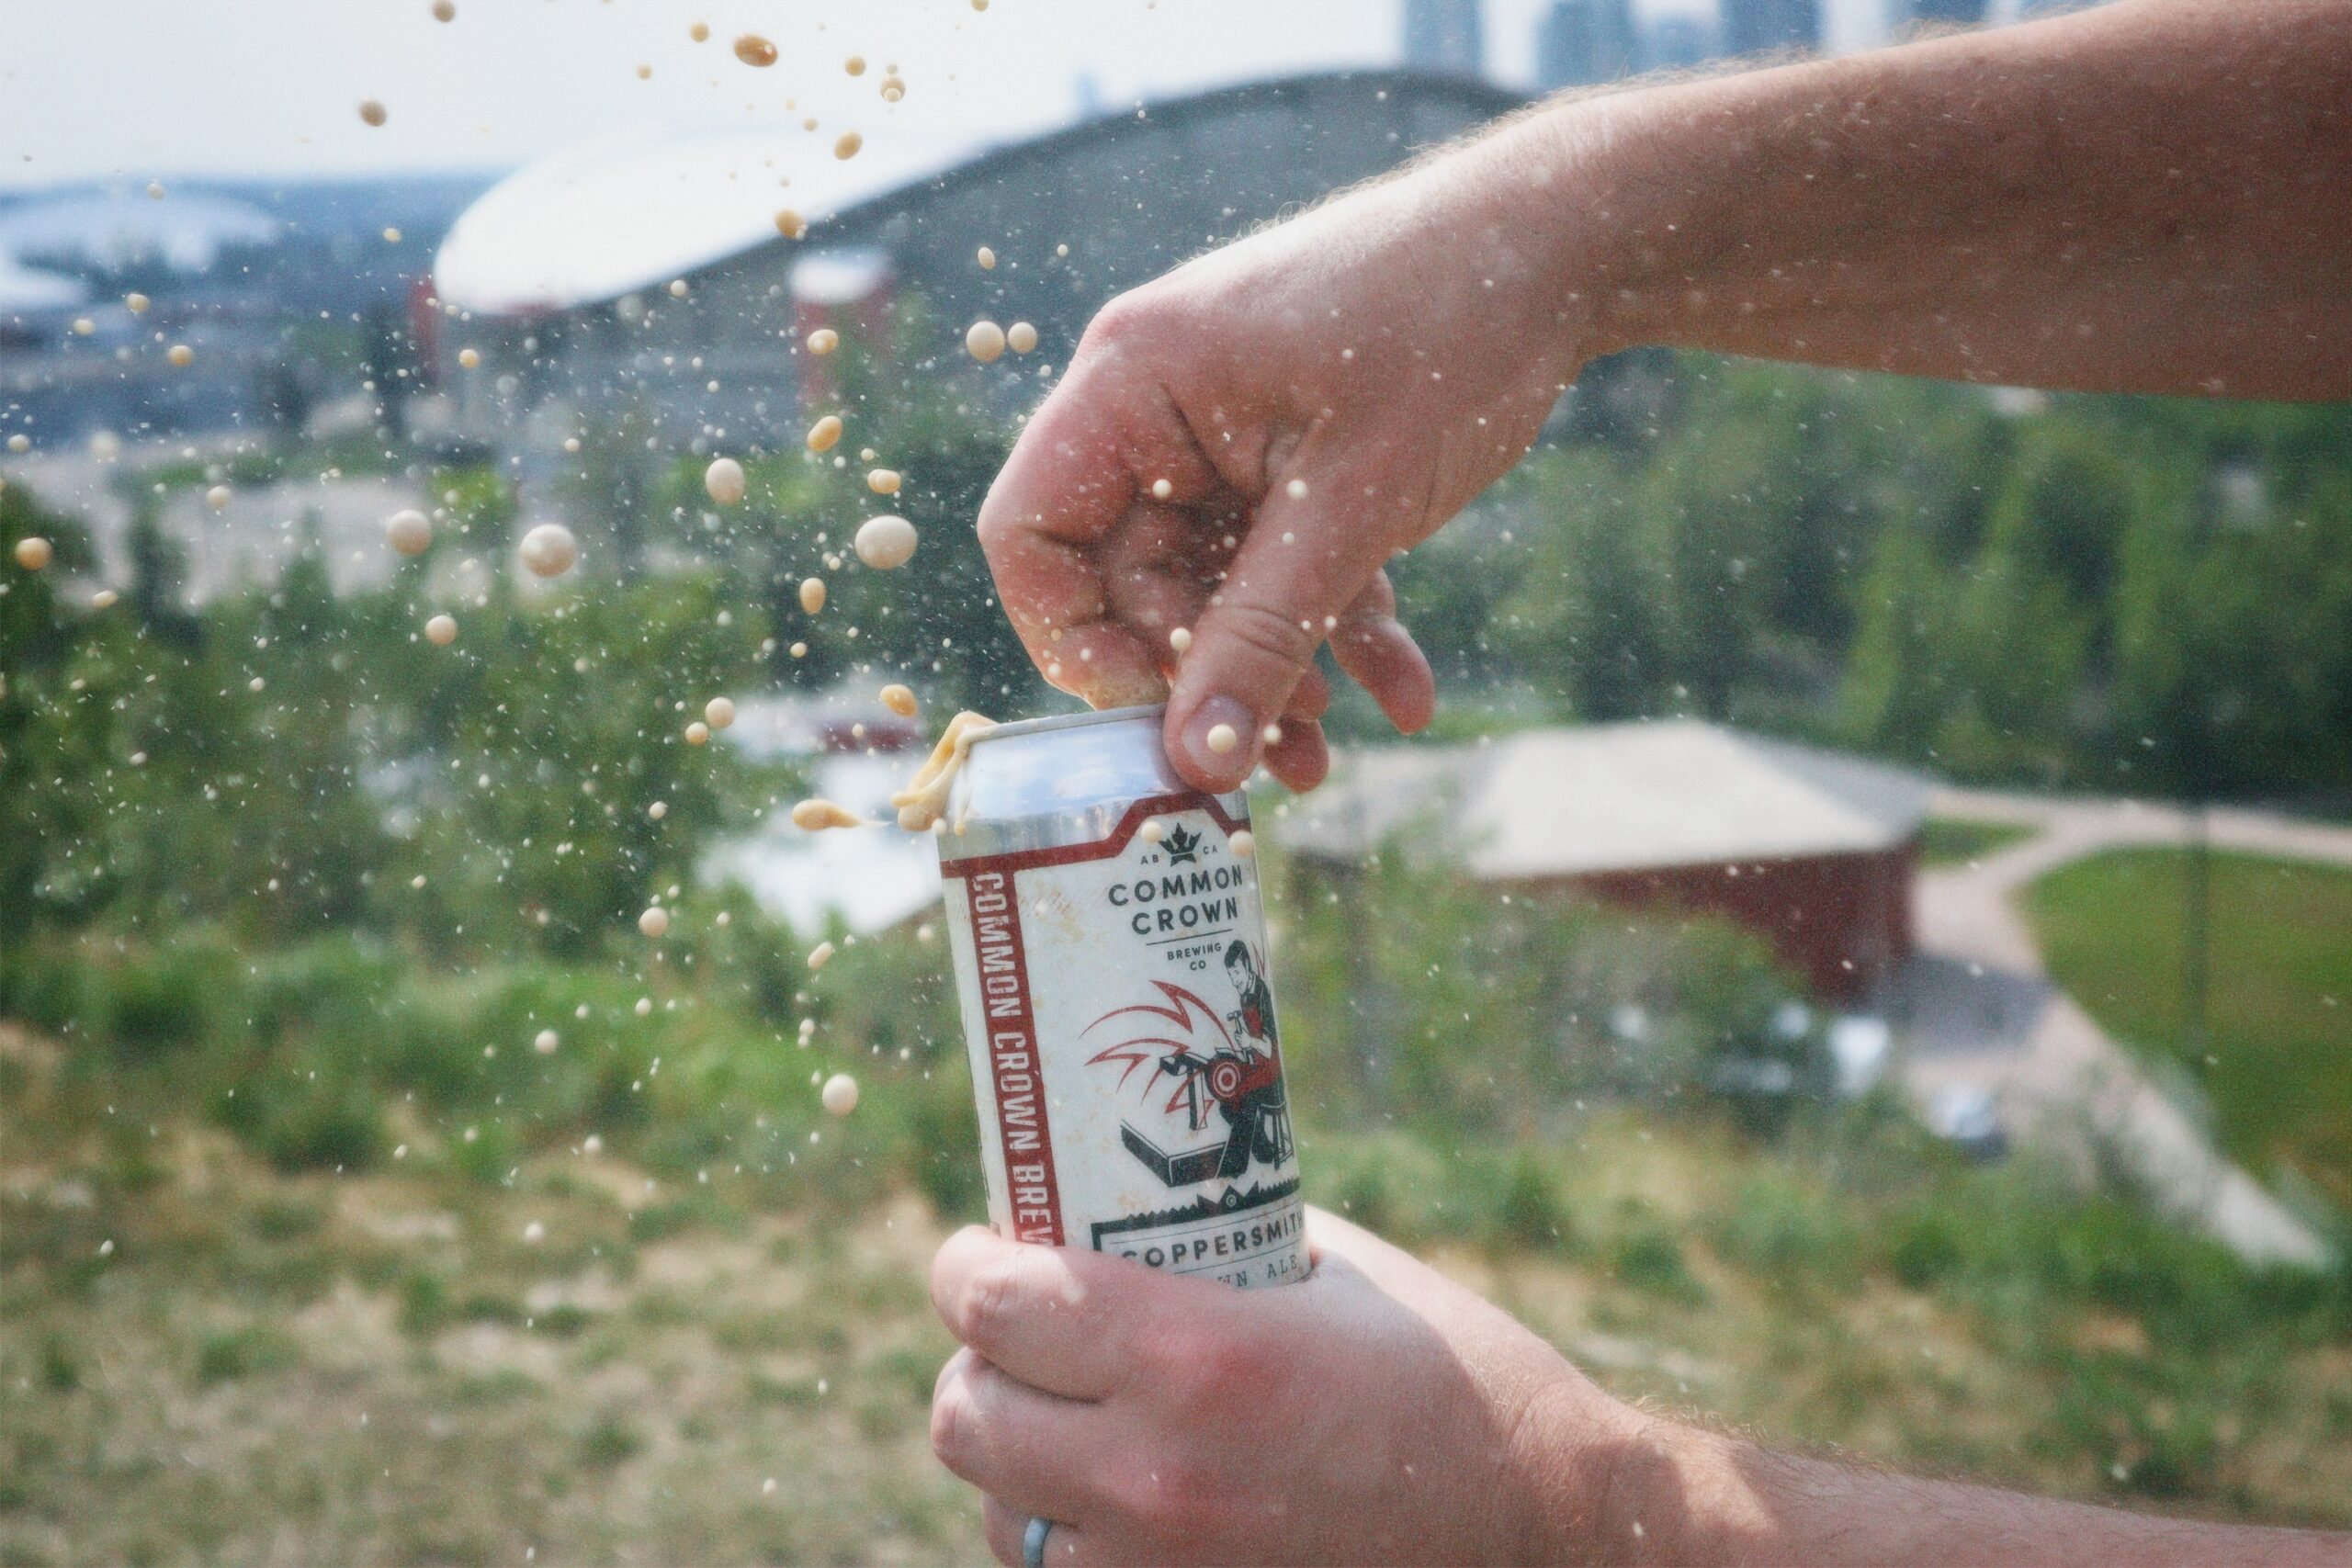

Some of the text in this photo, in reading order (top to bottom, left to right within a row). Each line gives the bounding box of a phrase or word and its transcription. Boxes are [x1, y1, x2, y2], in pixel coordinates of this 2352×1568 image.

[1140, 844, 1218, 865] AB CA
[1108, 864, 1243, 907] COMMON
[1131, 897, 1238, 935] CROWN
[974, 872, 1023, 1019] COMMON
[1167, 942, 1222, 961] BREWING
[1189, 960, 1207, 971] CO
[994, 1032, 1041, 1150] CROWN
[1122, 1209, 1305, 1269] OPPERSMITH
[1267, 1255, 1298, 1279] ALE
